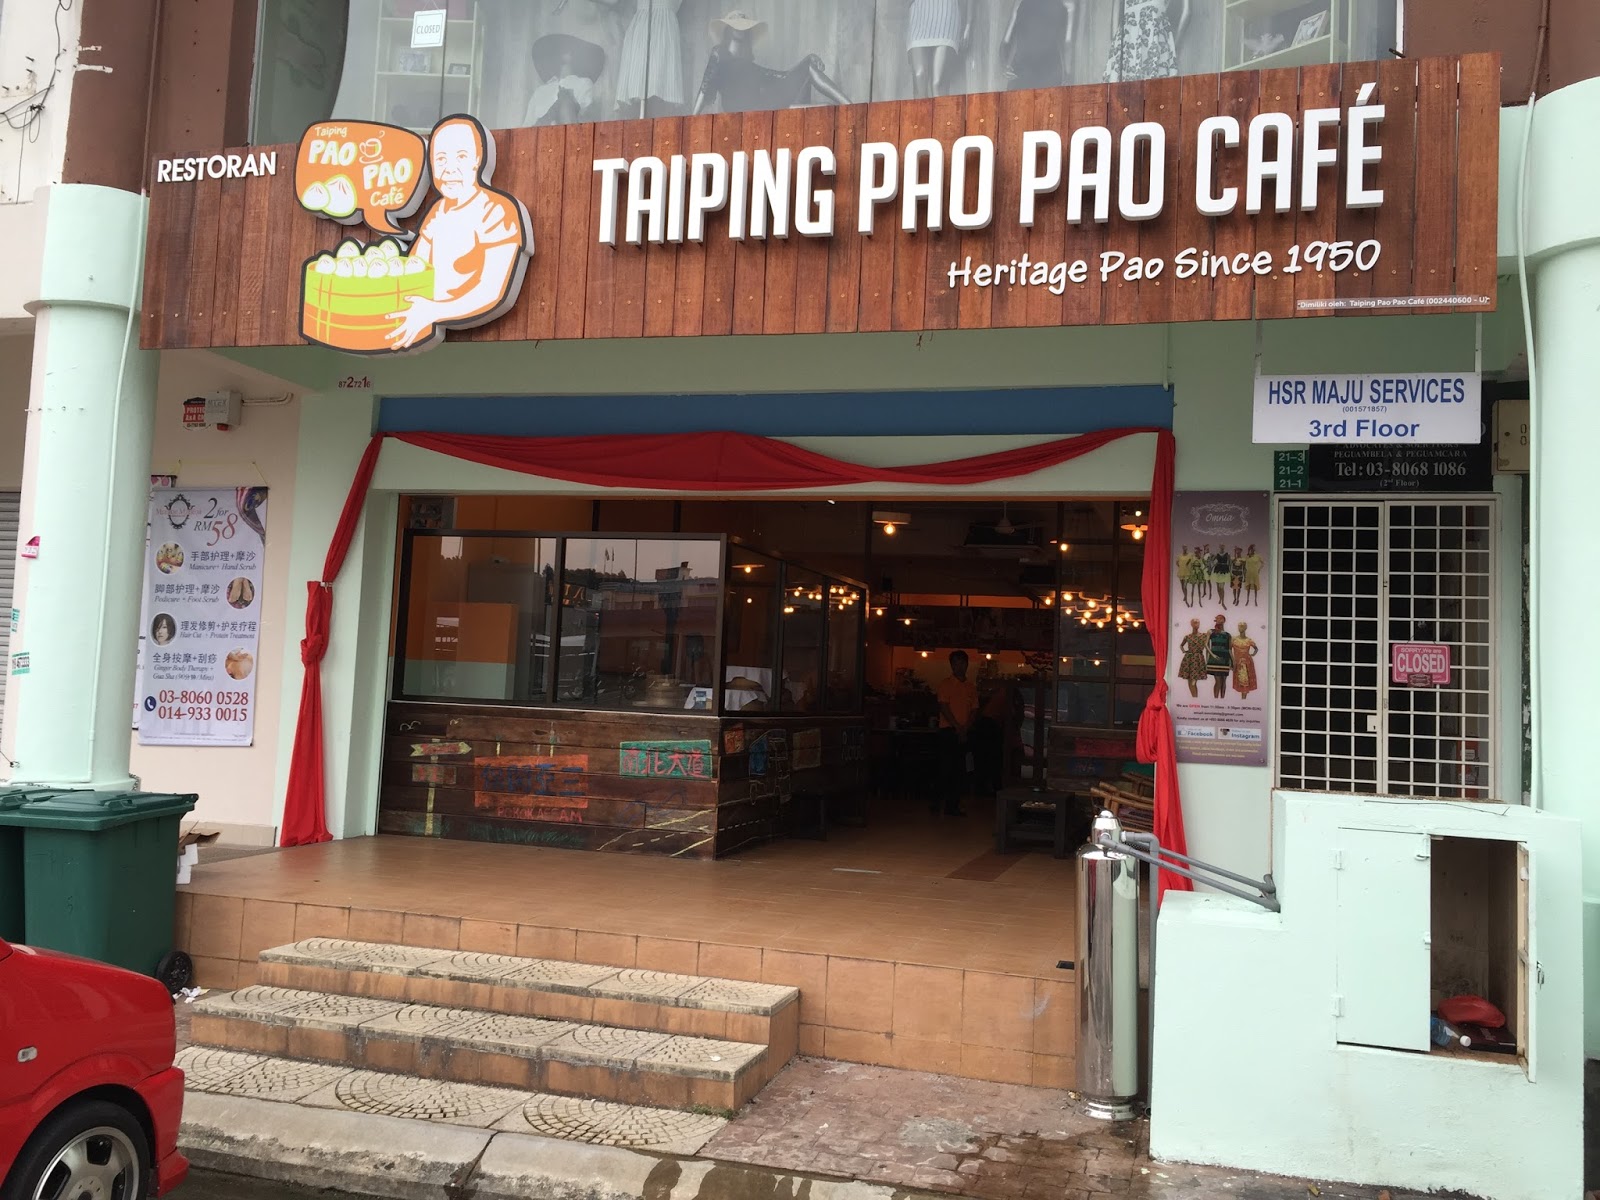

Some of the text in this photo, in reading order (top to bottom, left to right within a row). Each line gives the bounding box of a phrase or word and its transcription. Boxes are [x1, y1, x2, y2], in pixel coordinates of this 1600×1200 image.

[416, 24, 441, 34] CLOSED
[314, 126, 347, 138] Taiping
[308, 139, 358, 167] PAO
[157, 151, 277, 183] RESTORAN
[592, 82, 1386, 246] TAIPING PAO PAO CAFÉ
[363, 158, 413, 190] PAO
[370, 186, 405, 207] Café
[947, 239, 1382, 295] Heritage Pao Since 1950
[1300, 300, 1326, 308] Dimiliki
[1349, 299, 1375, 308] Taiping
[1407, 297, 1424, 305] Café
[1268, 378, 1465, 405] HSR MAJU SERVICES
[1342, 406, 1388, 414] (001571857)
[1309, 419, 1420, 438] 3rd Floor
[1395, 450, 1403, 458] &
[1278, 465, 1304, 475] 21-2
[1334, 461, 1467, 476] Tel: 03-8068 1086
[1279, 478, 1302, 488] 21-1
[1395, 479, 1420, 487] Floor)
[203, 497, 218, 519] 2
[213, 508, 229, 520] for
[1205, 513, 1235, 522] Omnia
[172, 664, 186, 672] Body
[187, 664, 208, 673] Therapy
[1397, 653, 1446, 674] CLOSED
[159, 689, 249, 706] 03-8060 0528
[158, 706, 247, 722] 014-933 0015
